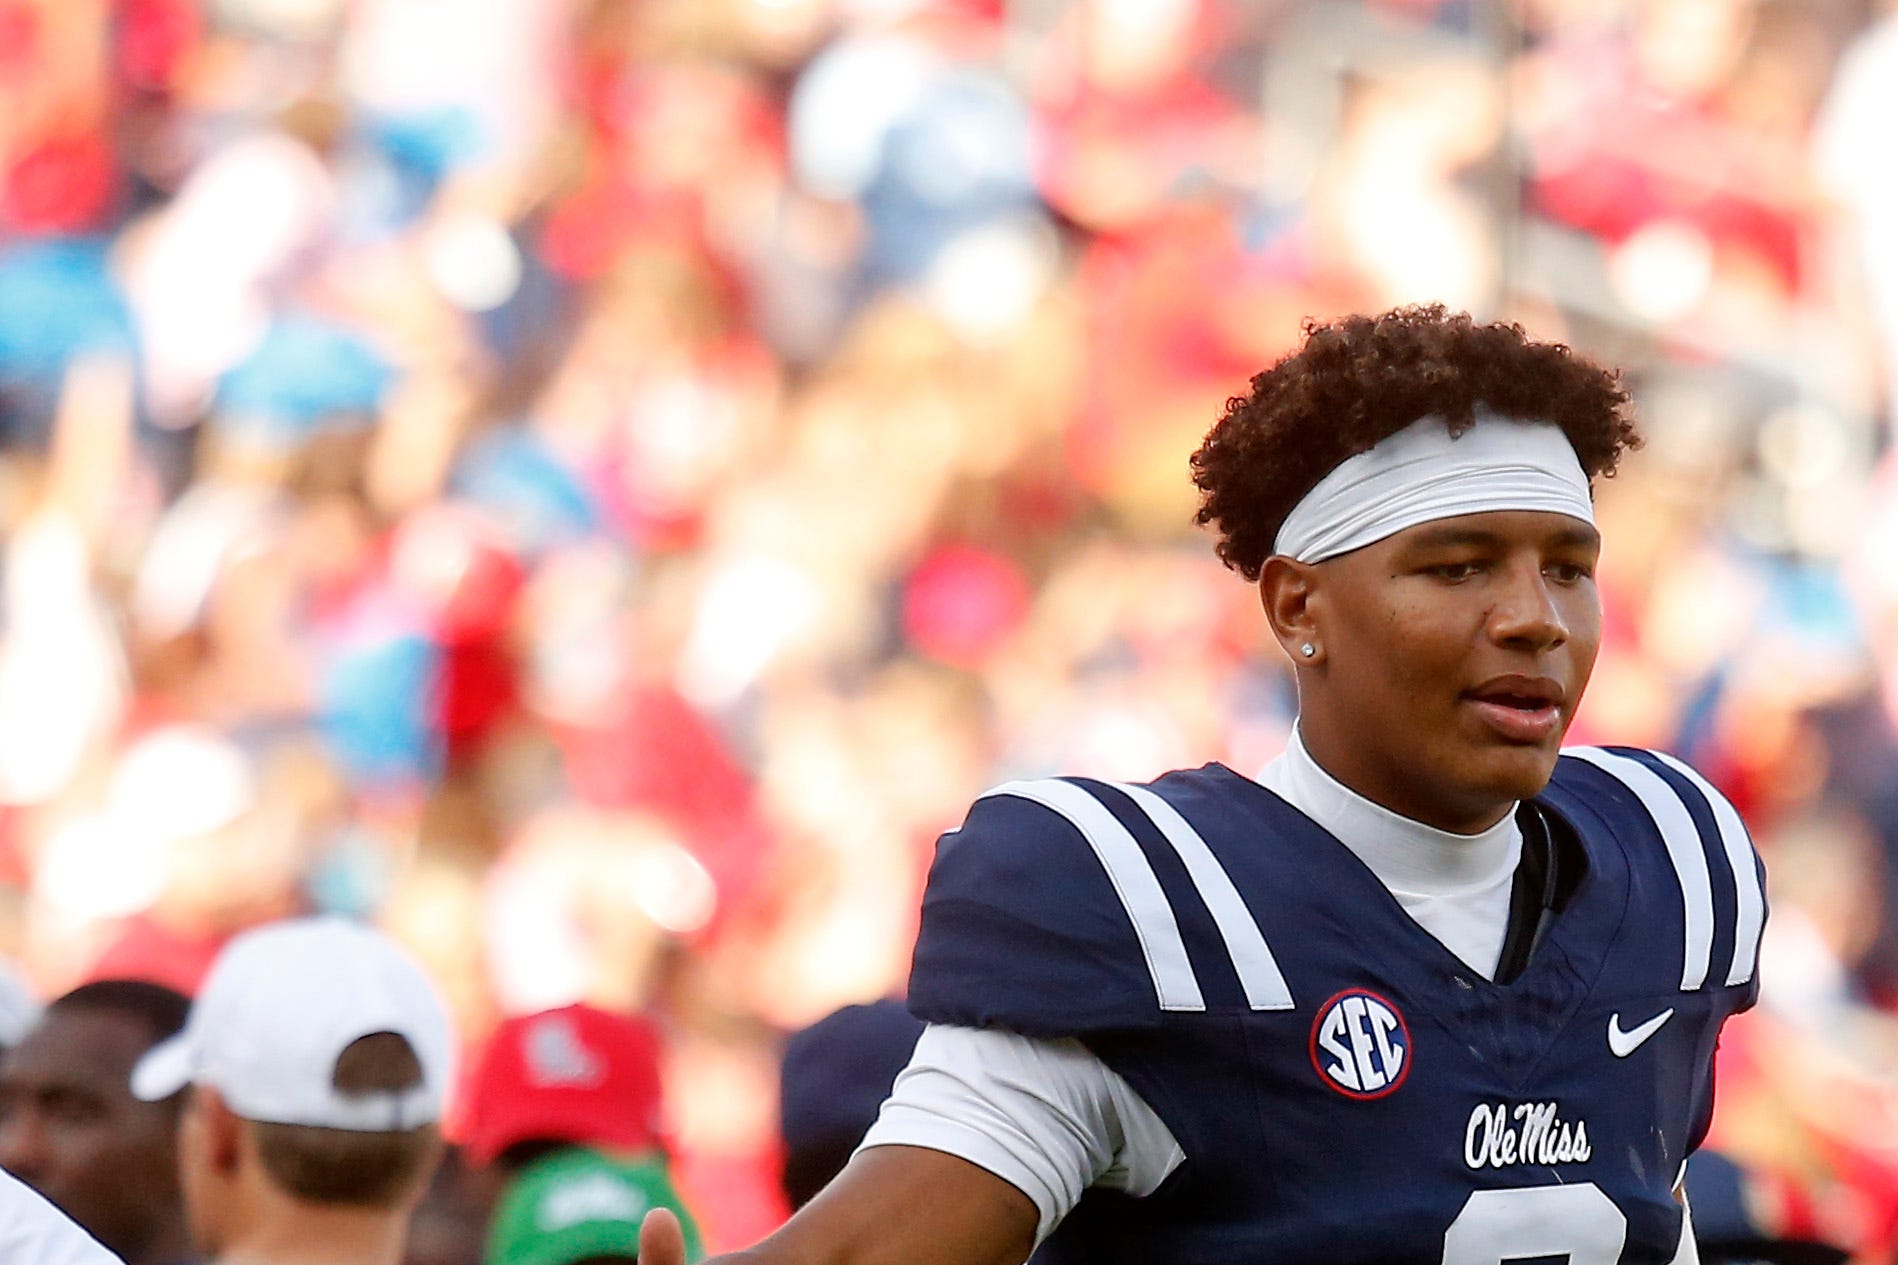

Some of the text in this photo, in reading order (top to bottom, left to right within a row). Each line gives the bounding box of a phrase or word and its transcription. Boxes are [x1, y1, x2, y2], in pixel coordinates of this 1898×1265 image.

[1318, 996, 1404, 1091] SEC
[1464, 1101, 1592, 1169] Ole Miss
